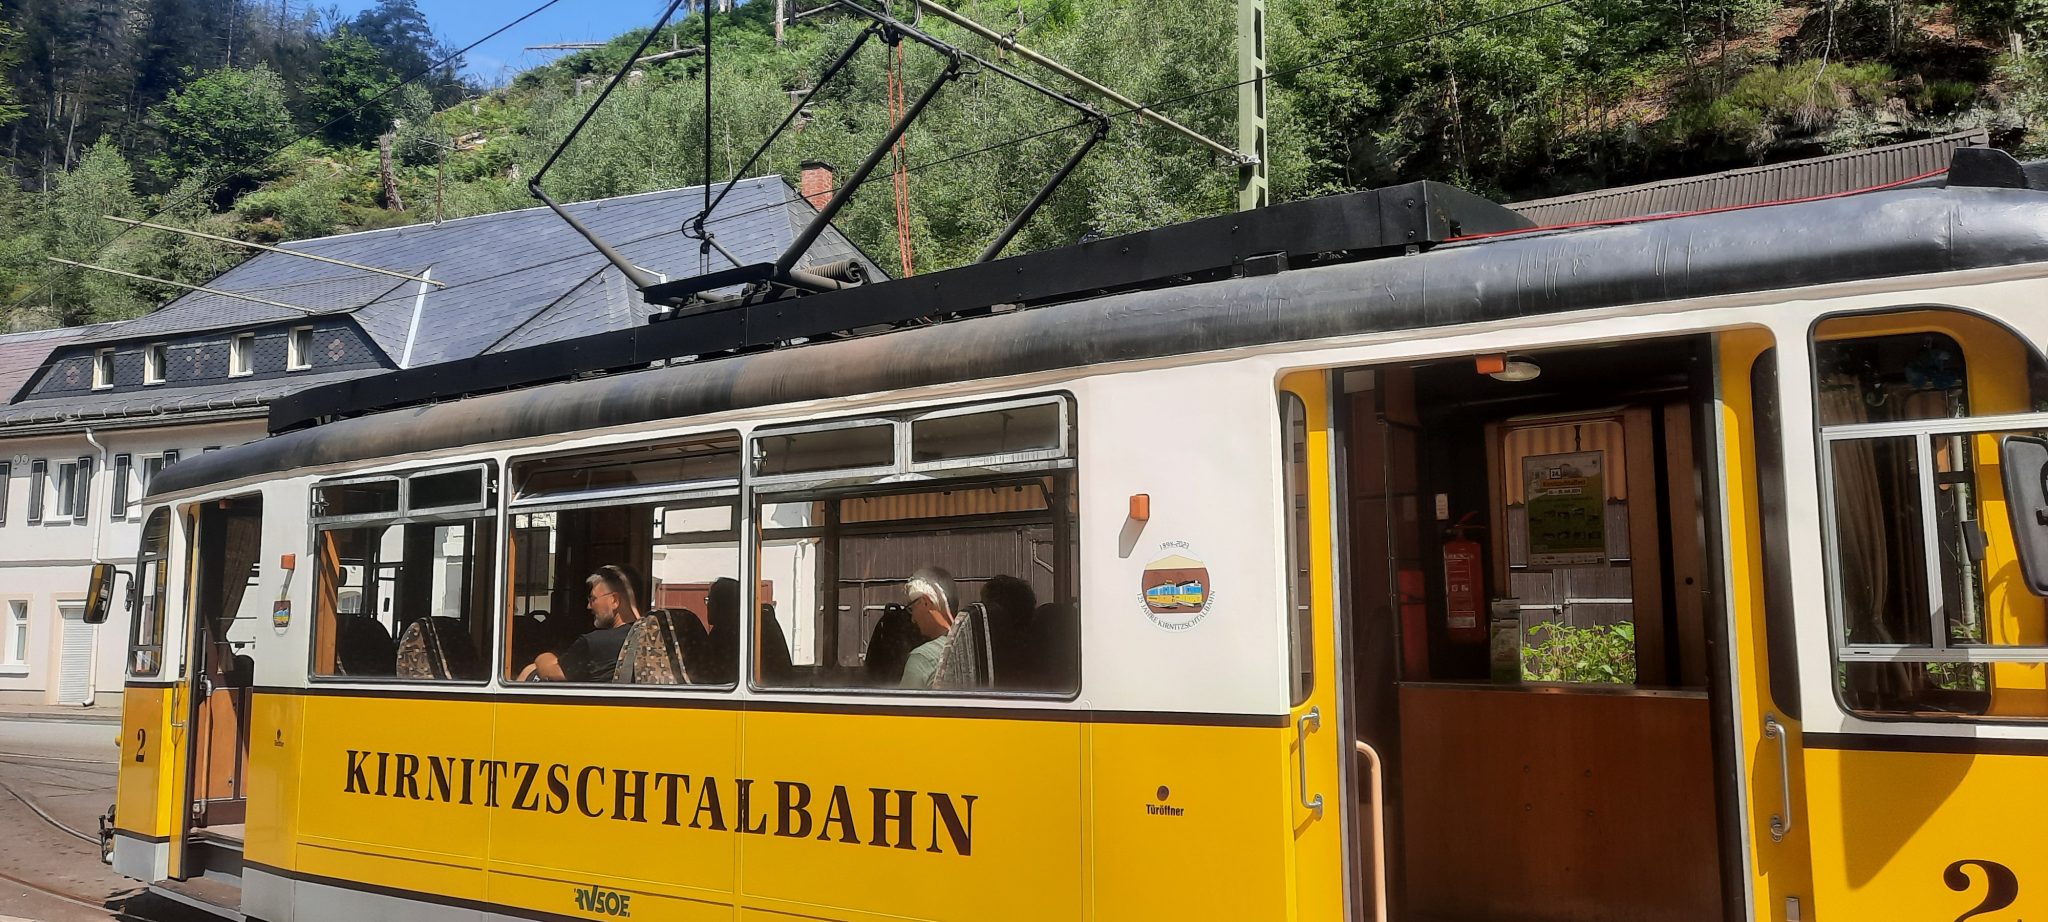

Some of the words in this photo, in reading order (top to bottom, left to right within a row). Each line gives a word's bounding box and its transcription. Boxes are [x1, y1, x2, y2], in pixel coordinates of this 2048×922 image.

[1141, 603, 1158, 622] JAHRE
[1157, 591, 1216, 630] KIRNITZSCHTALBAHN
[136, 729, 146, 762] 2
[344, 750, 978, 856] KIRNITZSCHTALBAHN
[1146, 803, 1184, 816] Türöffner
